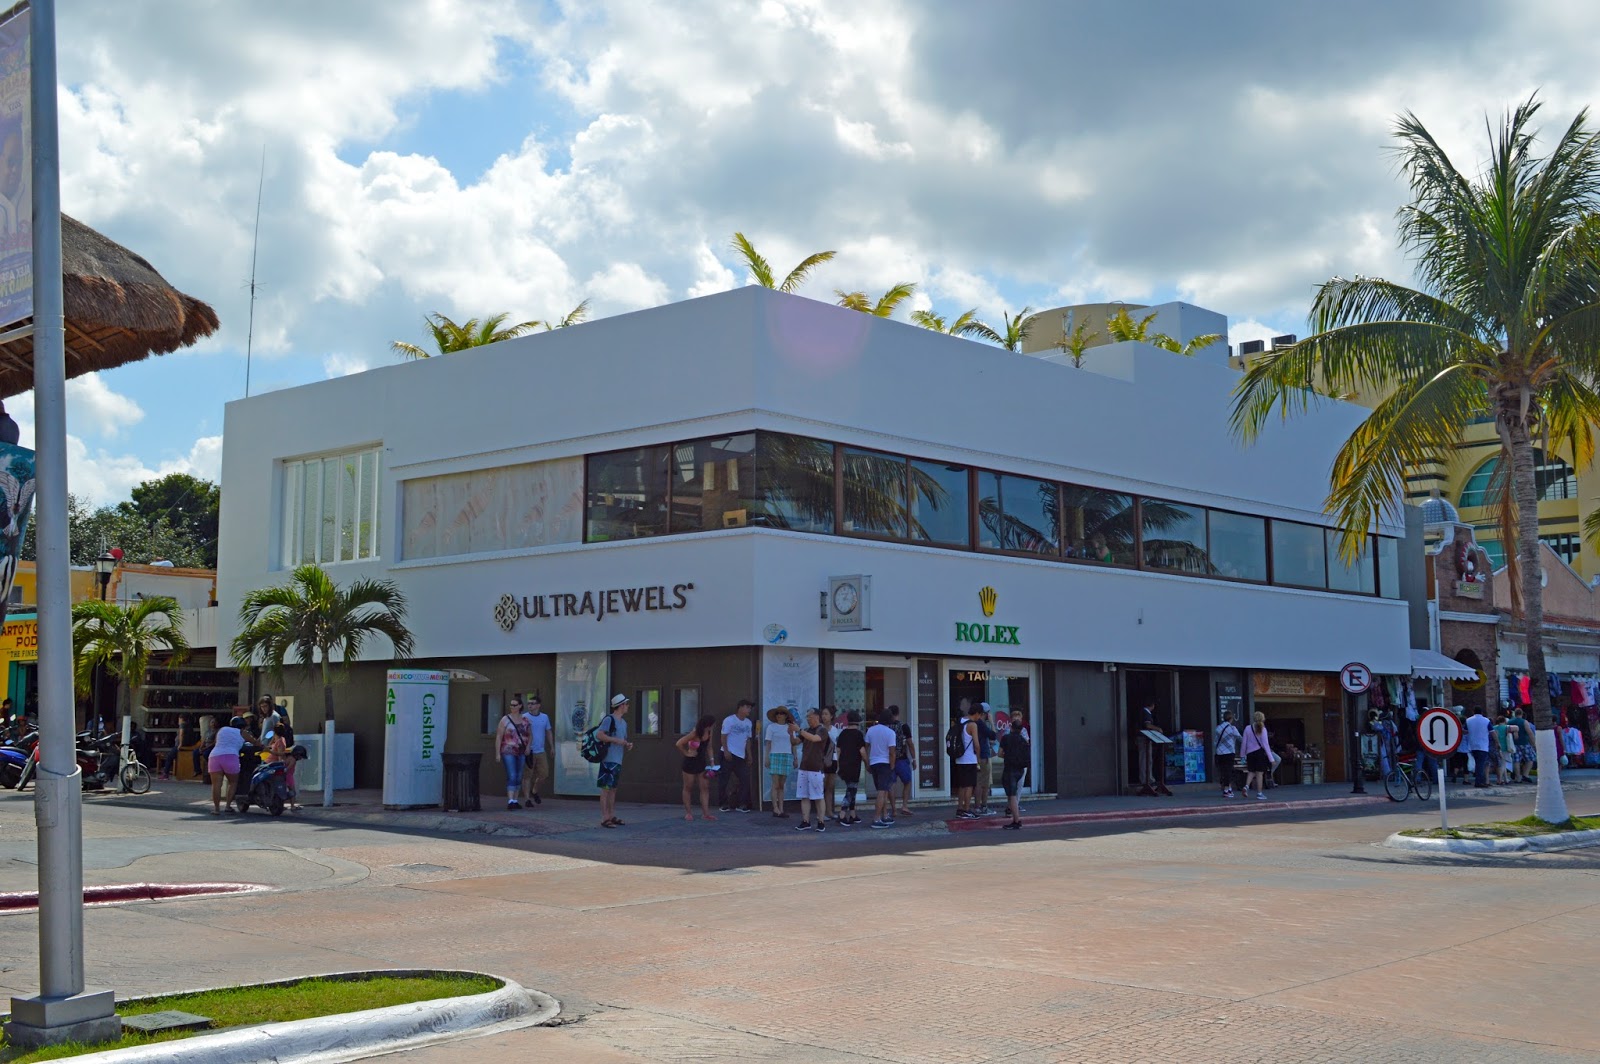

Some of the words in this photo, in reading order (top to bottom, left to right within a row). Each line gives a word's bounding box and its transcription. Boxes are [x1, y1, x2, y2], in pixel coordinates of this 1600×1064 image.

[523, 583, 688, 622] ULTRAJEWELS
[955, 622, 1021, 645] ROLEX
[388, 672, 413, 680] MÉXICO
[1349, 670, 1362, 686] E
[385, 688, 396, 725] ATM
[422, 693, 436, 760] Cashola
